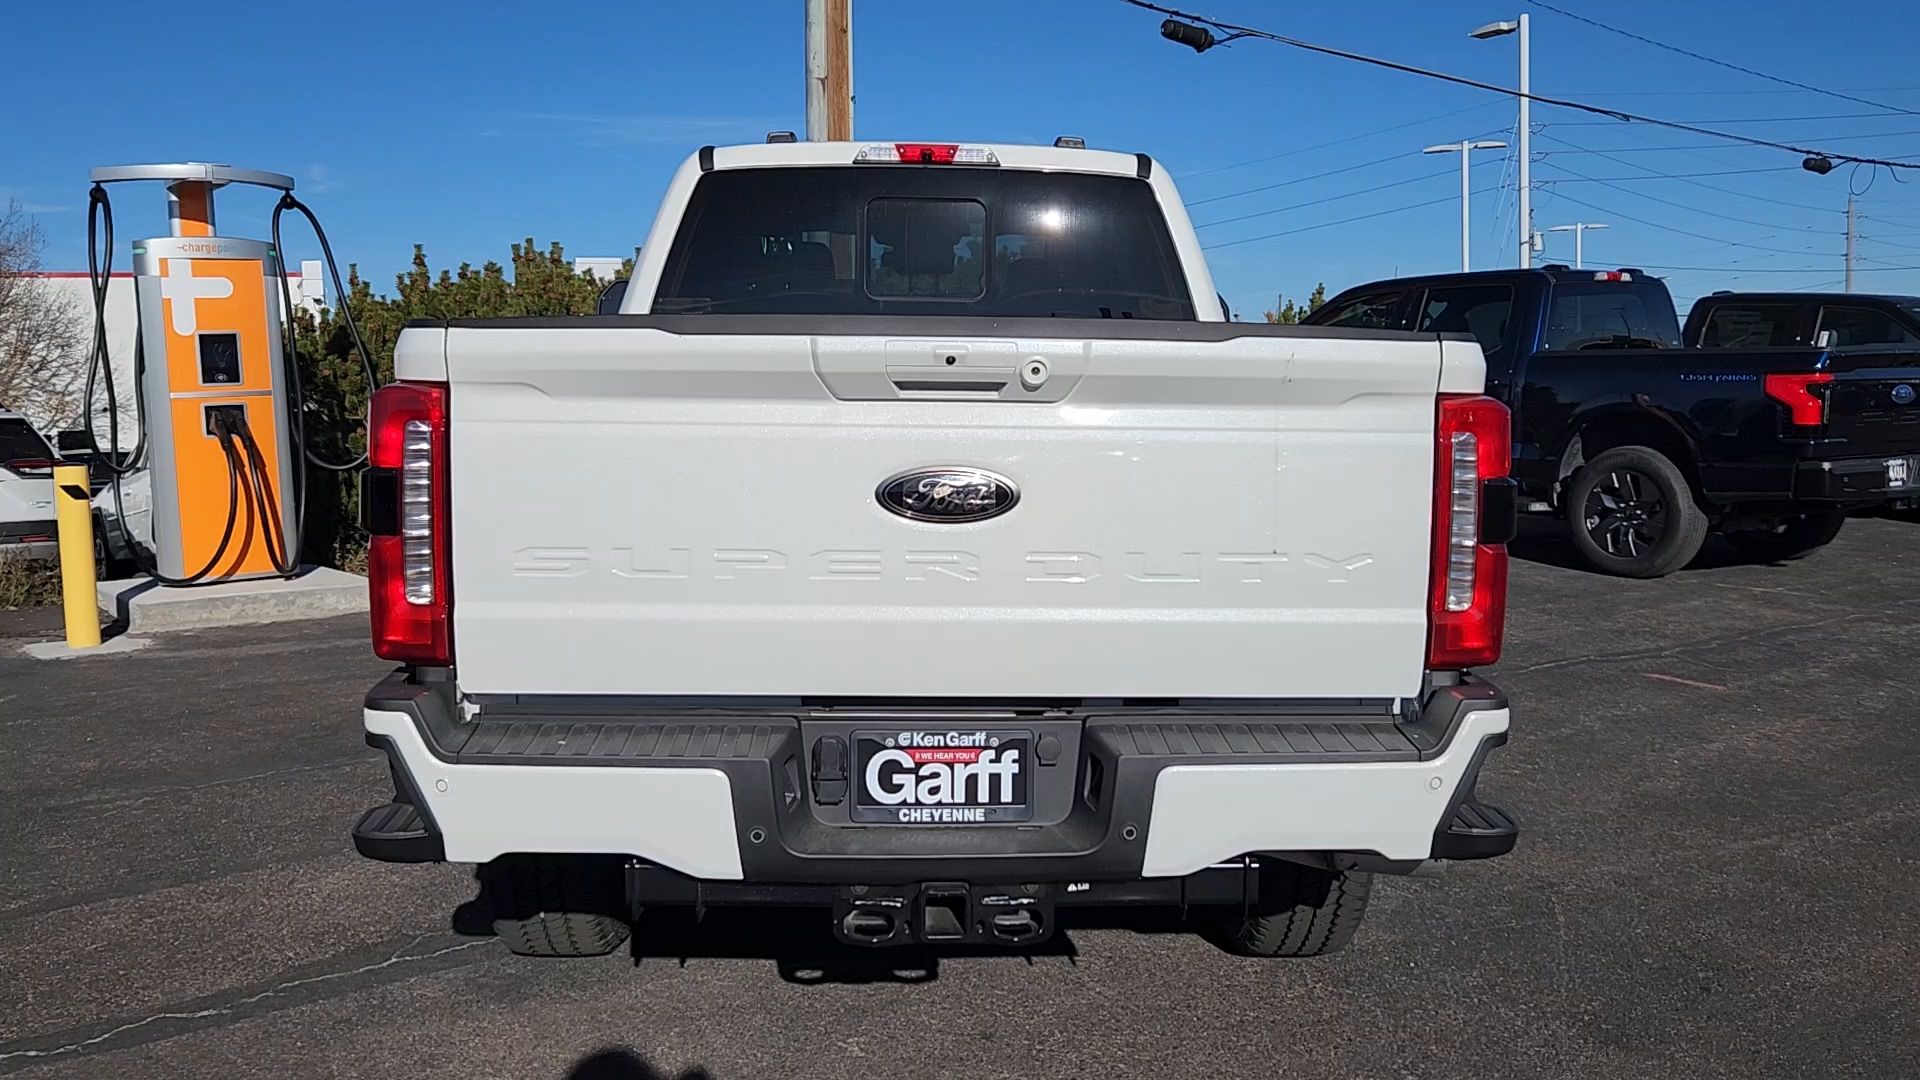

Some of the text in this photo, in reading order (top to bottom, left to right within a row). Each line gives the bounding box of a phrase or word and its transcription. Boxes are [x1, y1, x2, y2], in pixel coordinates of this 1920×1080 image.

[903, 478, 996, 512] Ford
[513, 546, 980, 582] SUPER
[1025, 551, 1374, 583] DUTY
[913, 732, 944, 746] Ken
[946, 732, 986, 746] Garff
[920, 752, 970, 760] WE HEAR YOU
[865, 749, 1019, 804] Garff
[898, 808, 985, 822] CHEYENNE
